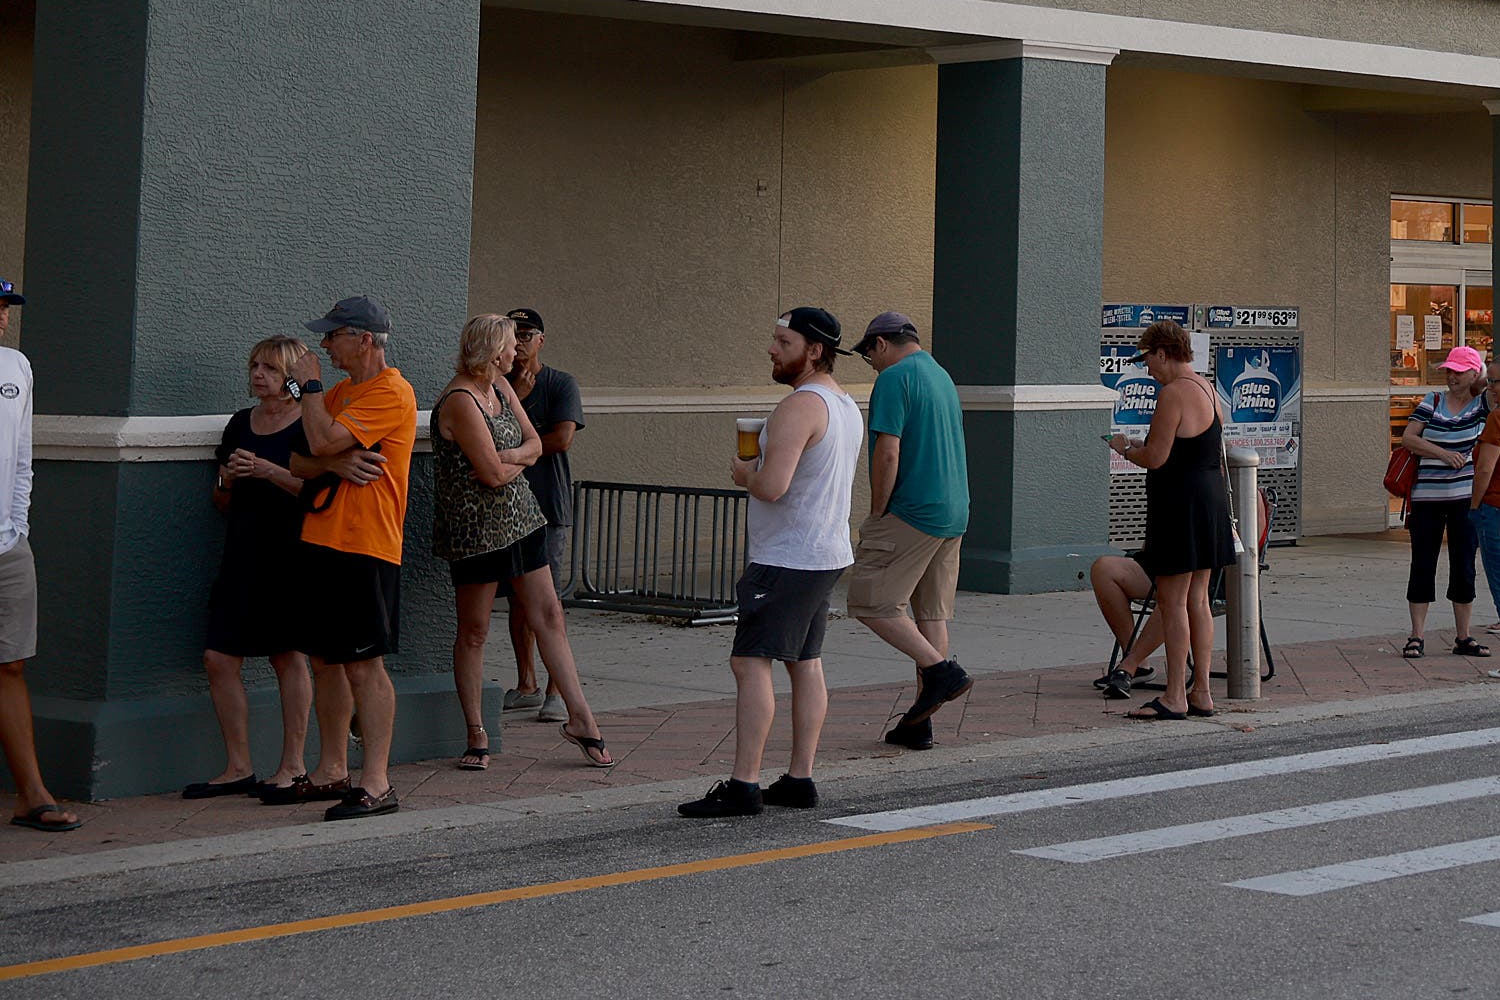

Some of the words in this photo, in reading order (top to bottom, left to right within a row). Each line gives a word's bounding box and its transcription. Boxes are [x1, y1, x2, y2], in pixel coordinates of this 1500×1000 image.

[1125, 383, 1155, 396] Blue
[1241, 382, 1270, 395] Blue
[1238, 395, 1276, 409] Rhino
